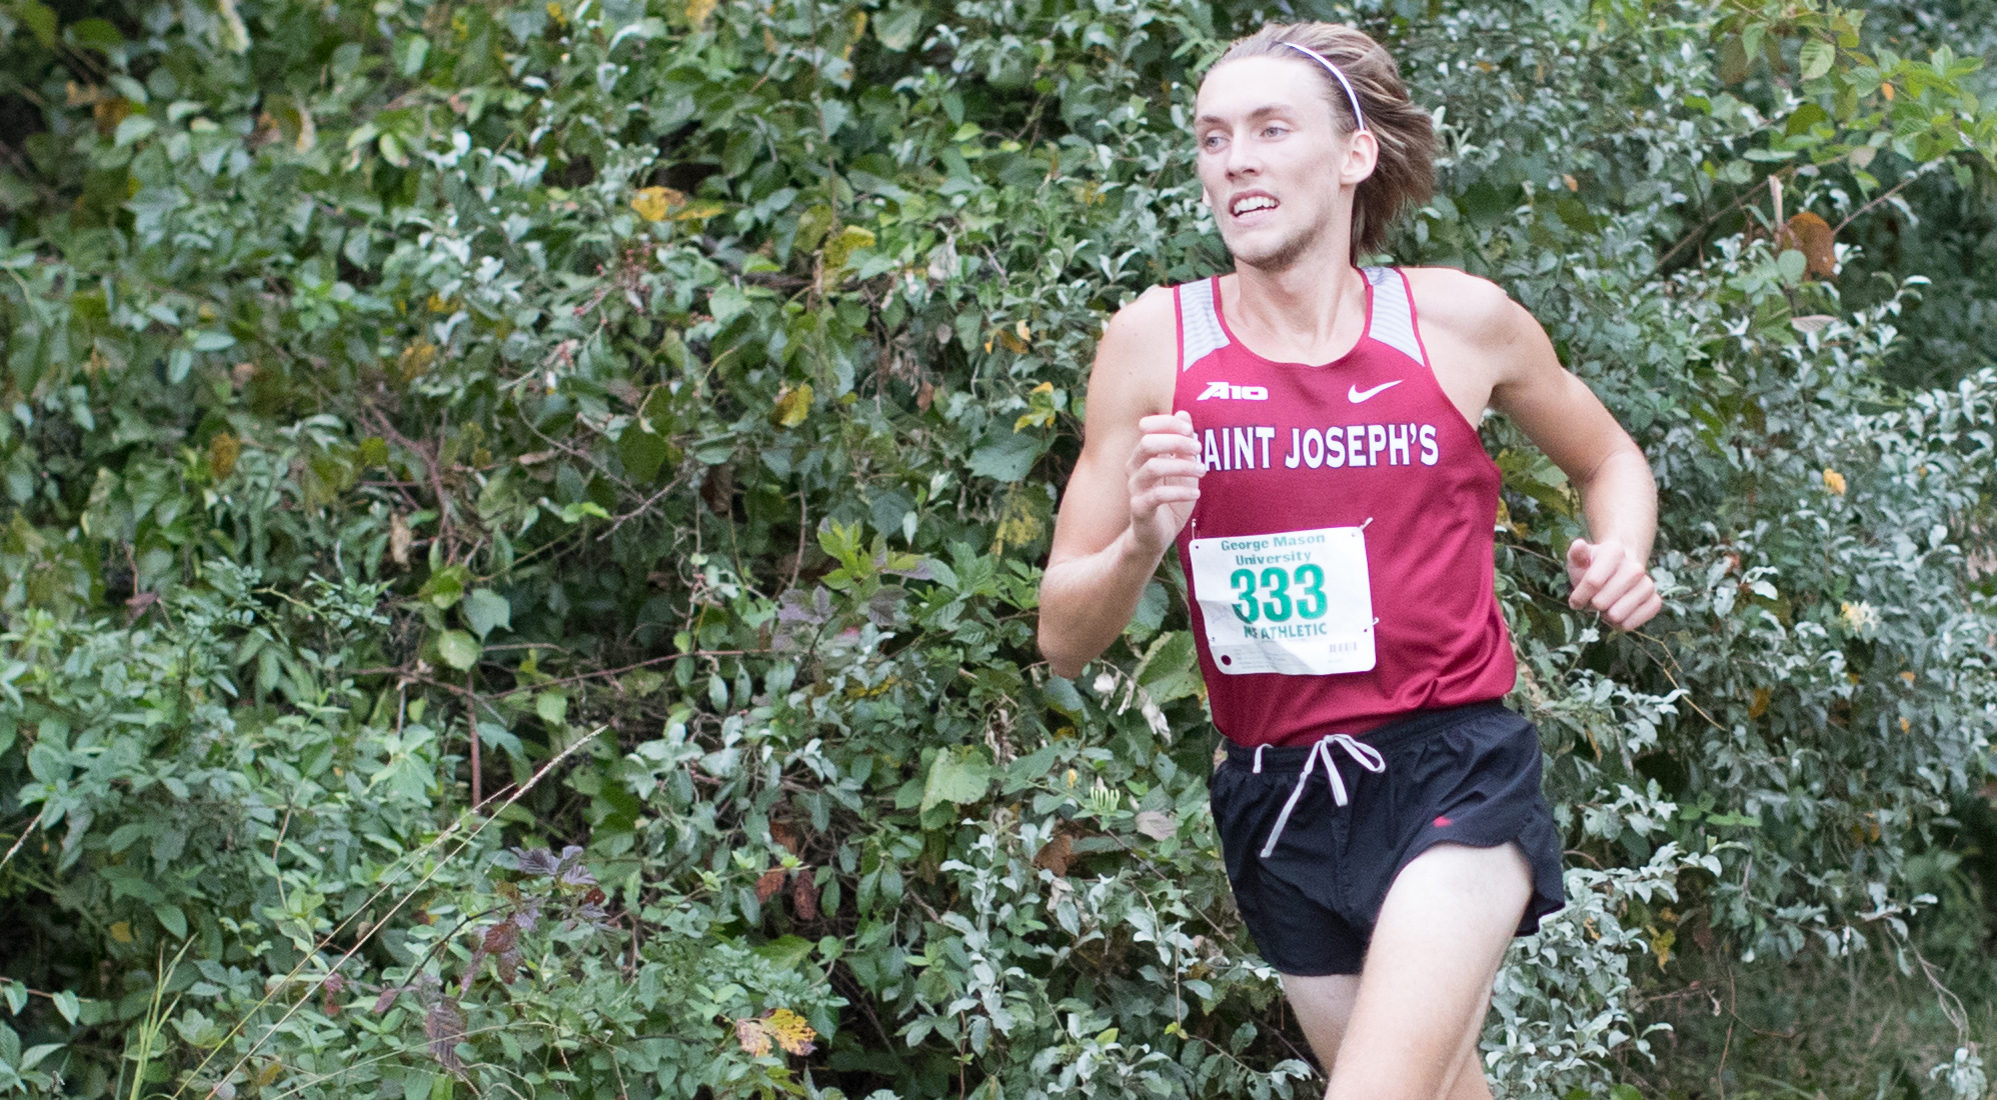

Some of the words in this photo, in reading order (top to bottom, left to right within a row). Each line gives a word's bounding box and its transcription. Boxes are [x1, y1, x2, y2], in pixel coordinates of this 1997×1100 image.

[1196, 381, 1269, 401] A10
[1192, 425, 1276, 472] AINT
[1284, 422, 1440, 470] JOSEPH'S
[1220, 539, 1269, 551] George
[1272, 534, 1326, 548] Mason
[1234, 551, 1312, 566] University
[1230, 563, 1329, 625] 333
[1260, 622, 1328, 640] ATHLETIC
